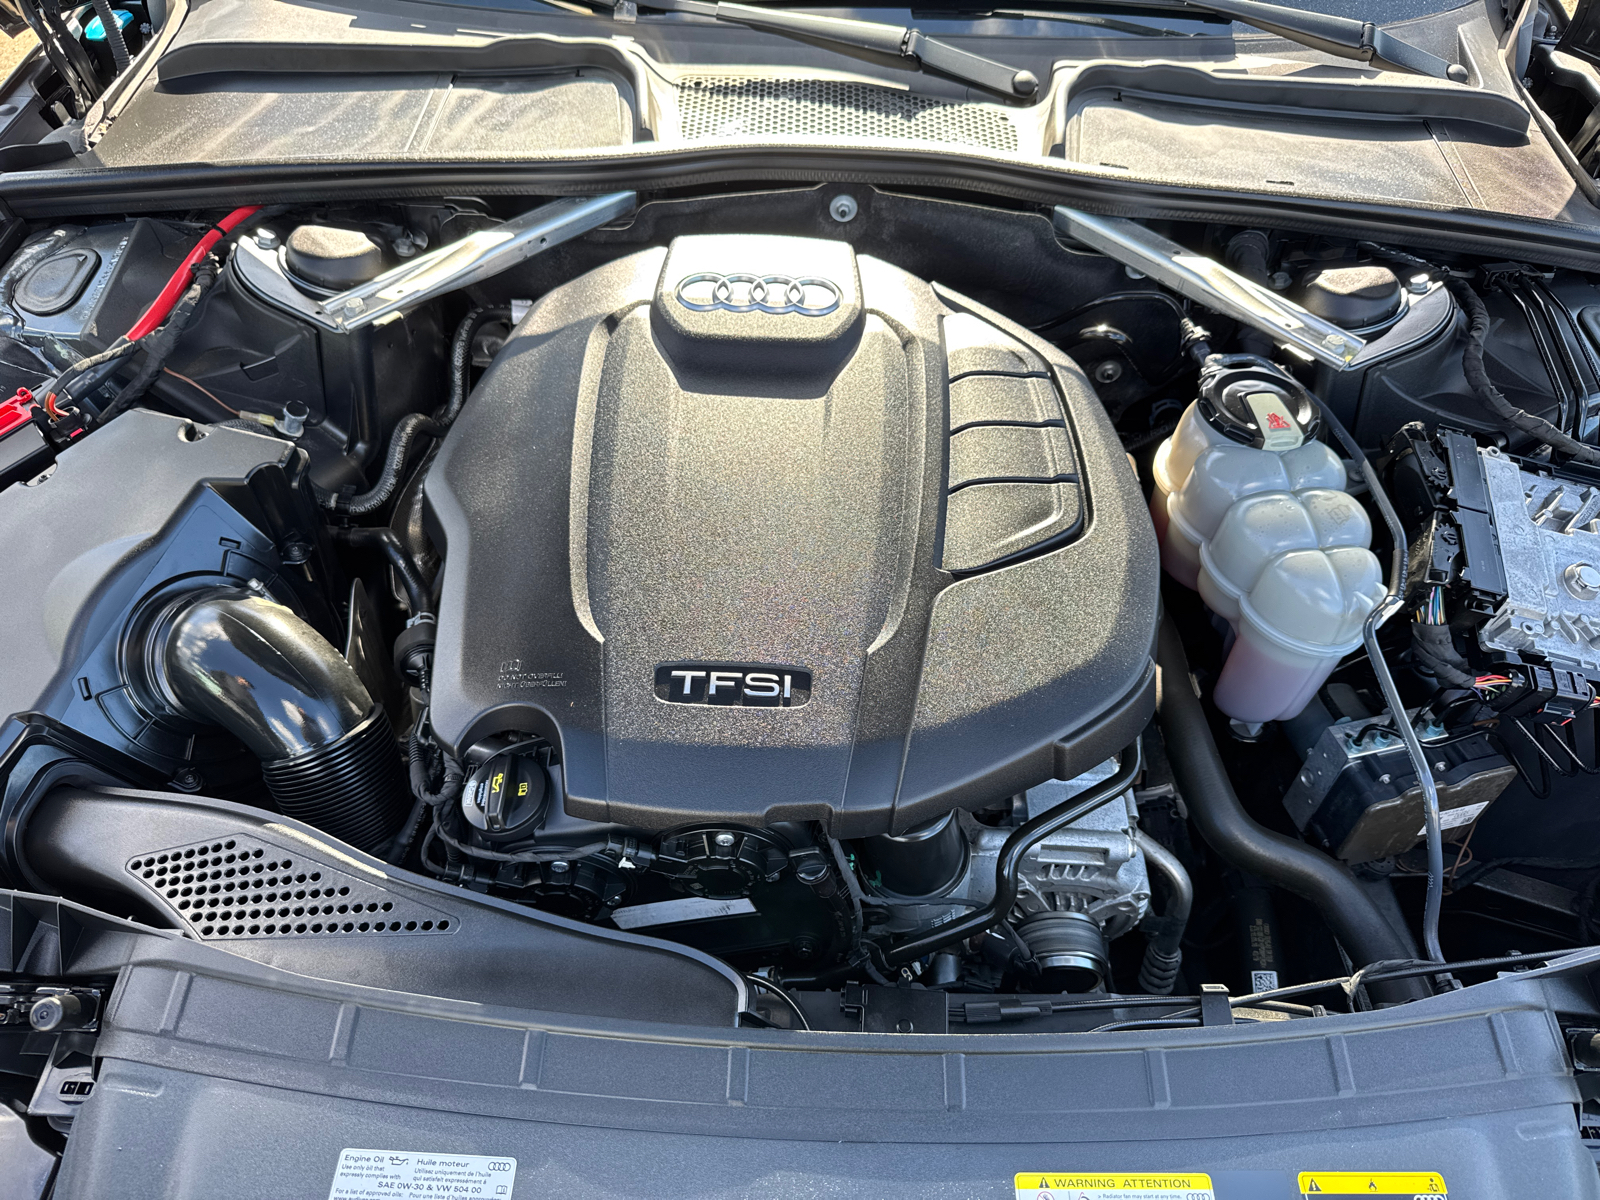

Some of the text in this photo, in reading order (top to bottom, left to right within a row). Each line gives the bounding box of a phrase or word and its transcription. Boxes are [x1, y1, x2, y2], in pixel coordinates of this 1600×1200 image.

[671, 670, 792, 699] TFSI
[344, 1154, 385, 1164] Engine Oil
[416, 1158, 437, 1166] Huile
[339, 1171, 364, 1179] expressly
[365, 1172, 388, 1180] complies
[434, 1169, 467, 1177] uniquement
[377, 1181, 395, 1189] SAE
[397, 1182, 424, 1191] 0W-30
[436, 1184, 452, 1192] VW
[453, 1185, 469, 1193] 504
[1054, 1178, 1191, 1189] WARNING ATTENTION
[366, 1190, 391, 1198] approved
